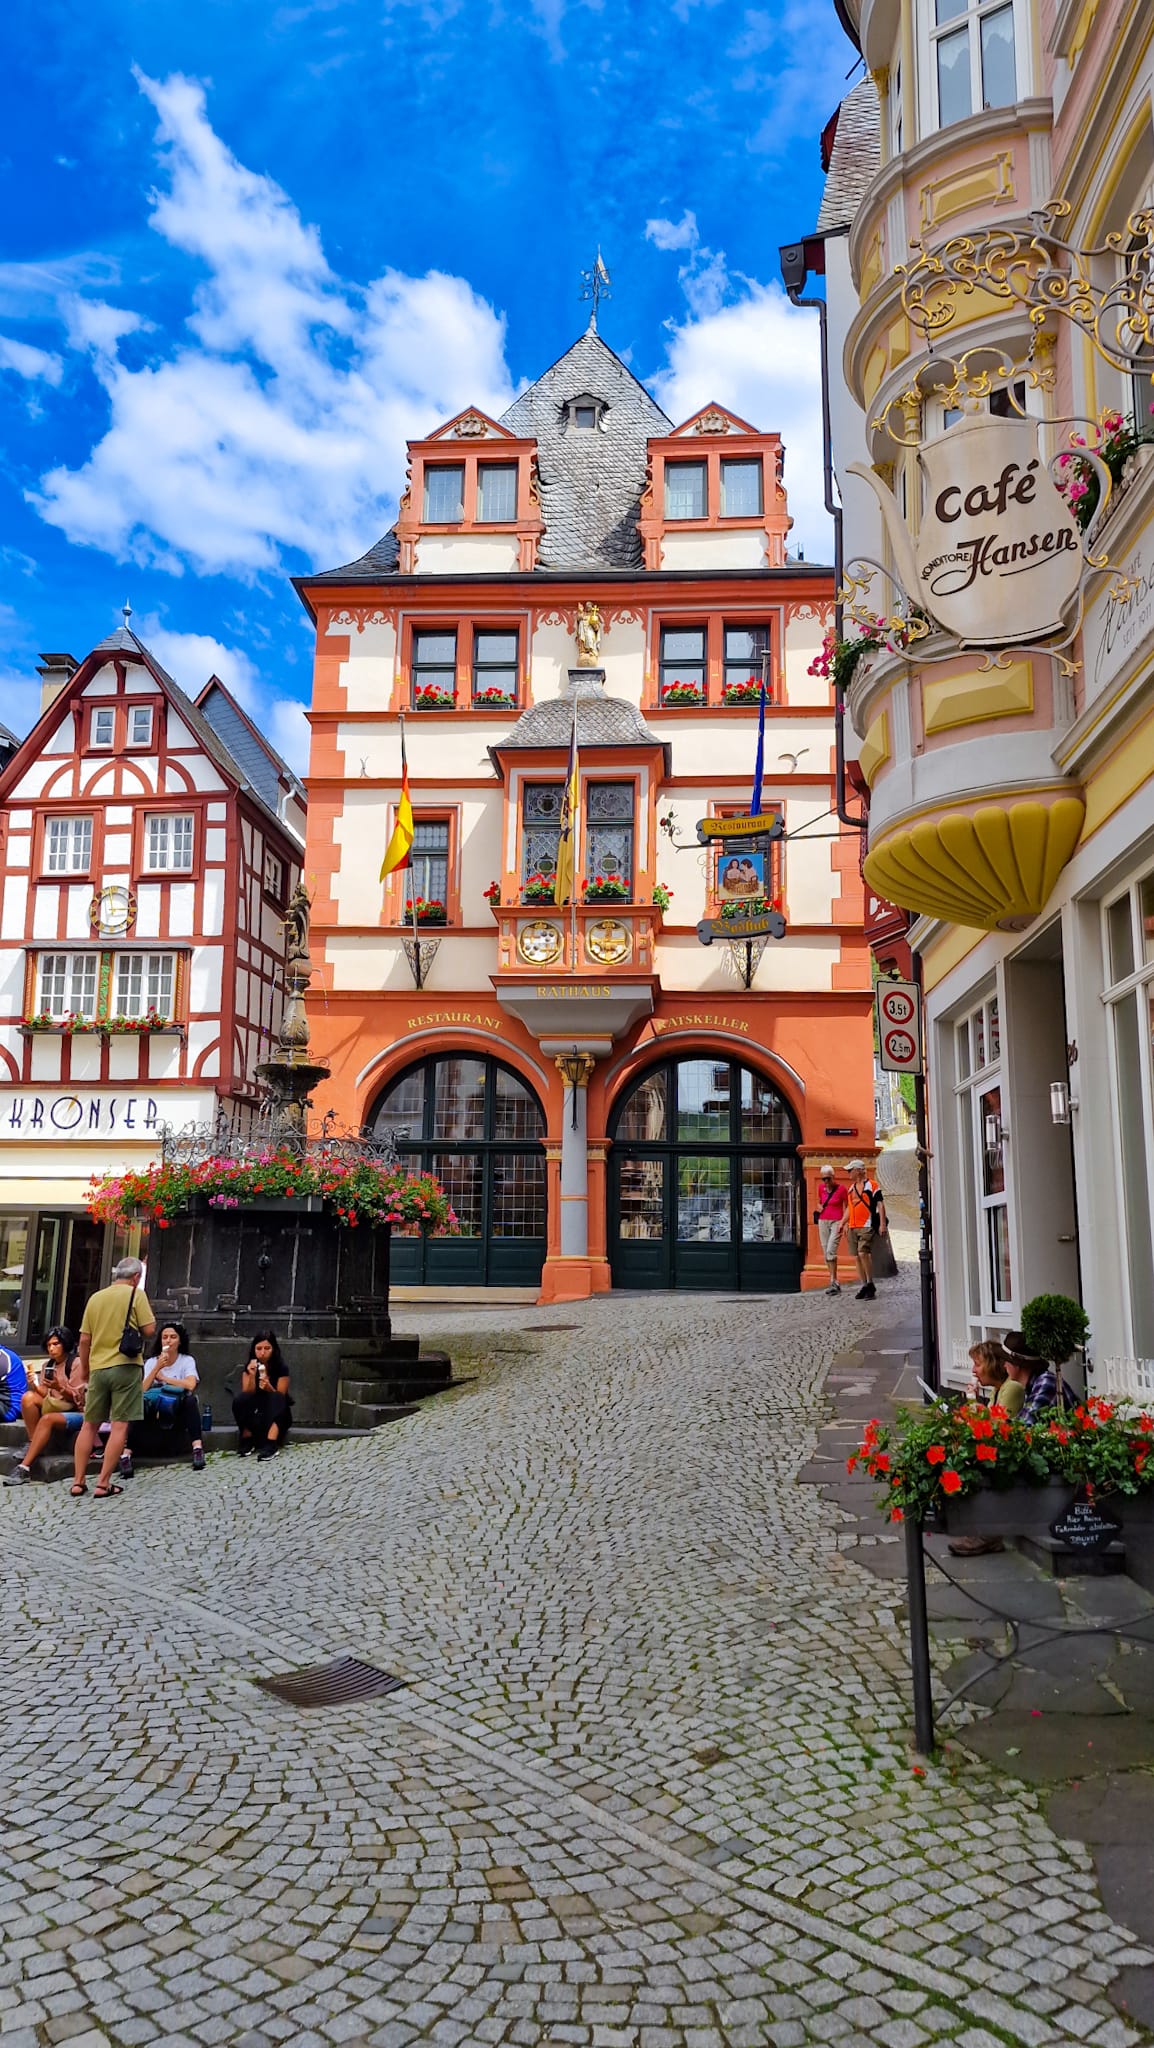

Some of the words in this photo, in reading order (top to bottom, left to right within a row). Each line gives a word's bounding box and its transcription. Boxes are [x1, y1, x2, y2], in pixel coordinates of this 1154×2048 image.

[920, 552, 973, 581] KONDITOREI
[931, 527, 1078, 597] Hansen
[710, 819, 767, 833] Restaurant
[536, 985, 611, 998] RATHAUS
[407, 1012, 503, 1029] RESTAURANT
[655, 1014, 749, 1032] RATSKELLER
[8, 1096, 158, 1130] KRONSER
